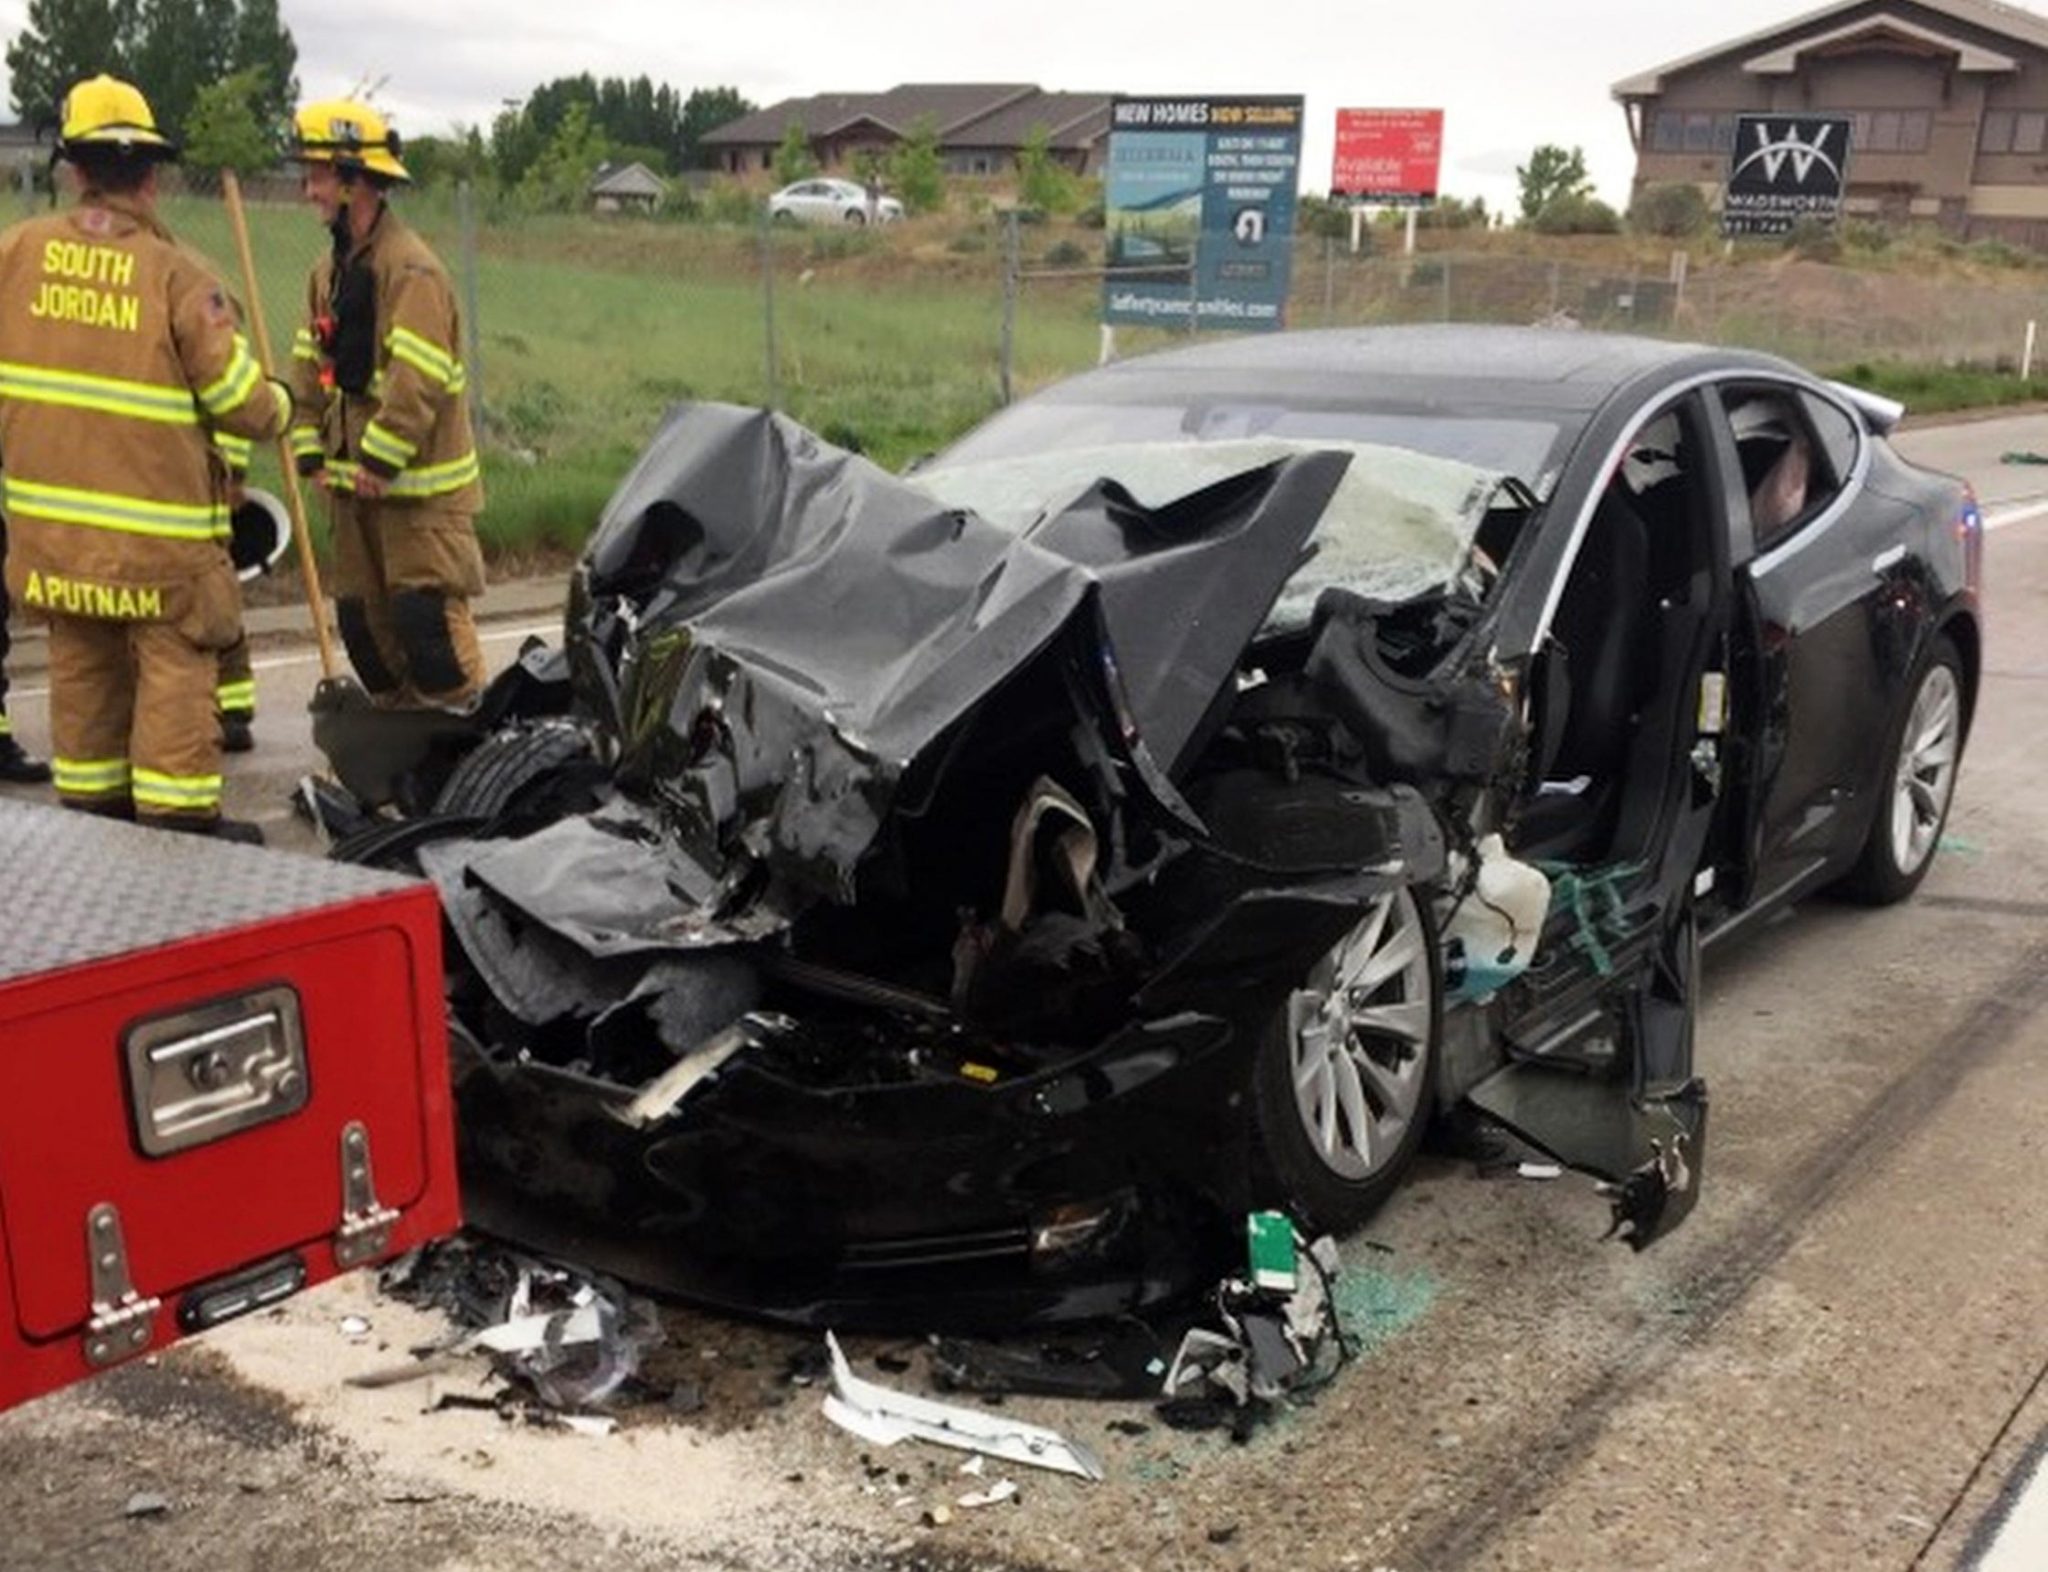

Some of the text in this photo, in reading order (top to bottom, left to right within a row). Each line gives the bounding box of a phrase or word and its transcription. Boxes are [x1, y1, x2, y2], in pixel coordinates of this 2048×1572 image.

[1114, 103, 1150, 123] NEW
[1152, 103, 1209, 124] HOMES
[44, 239, 134, 286] SOUTH
[30, 282, 139, 331] JORDAN
